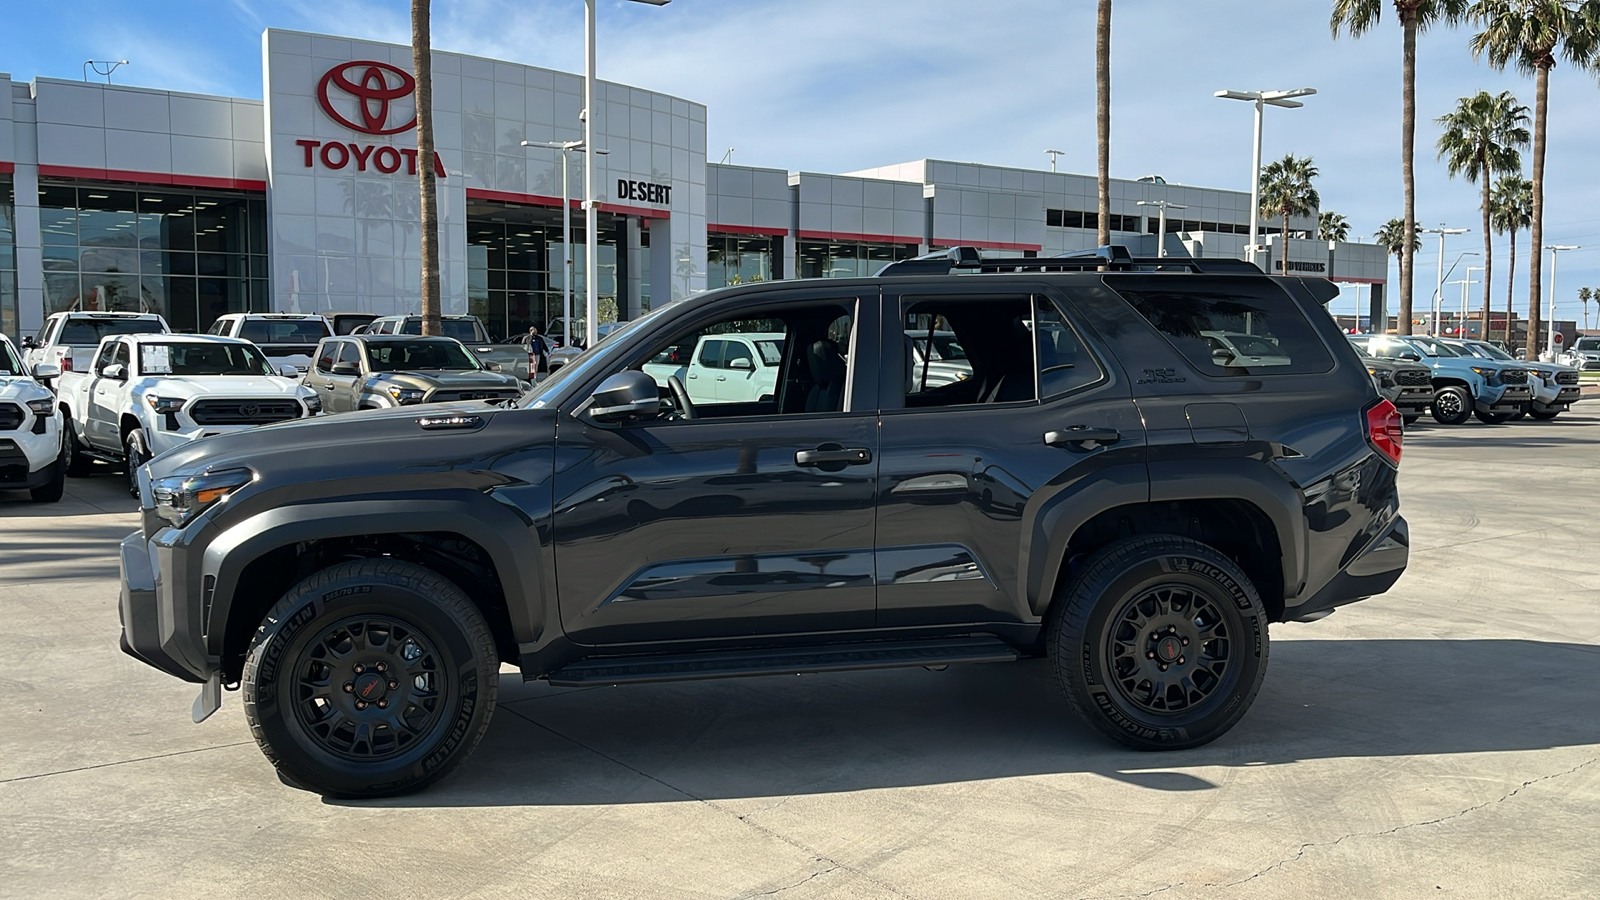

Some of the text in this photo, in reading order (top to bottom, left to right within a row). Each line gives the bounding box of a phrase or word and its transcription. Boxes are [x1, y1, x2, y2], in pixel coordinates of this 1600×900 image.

[617, 179, 672, 204] DESERT
[1275, 260, 1326, 272] UD VEHICLES
[1192, 561, 1250, 608] MICHELIN
[262, 606, 314, 682] MICHELIN
[426, 691, 474, 769] MICHELIN
[1097, 694, 1158, 740] MICHELIN
